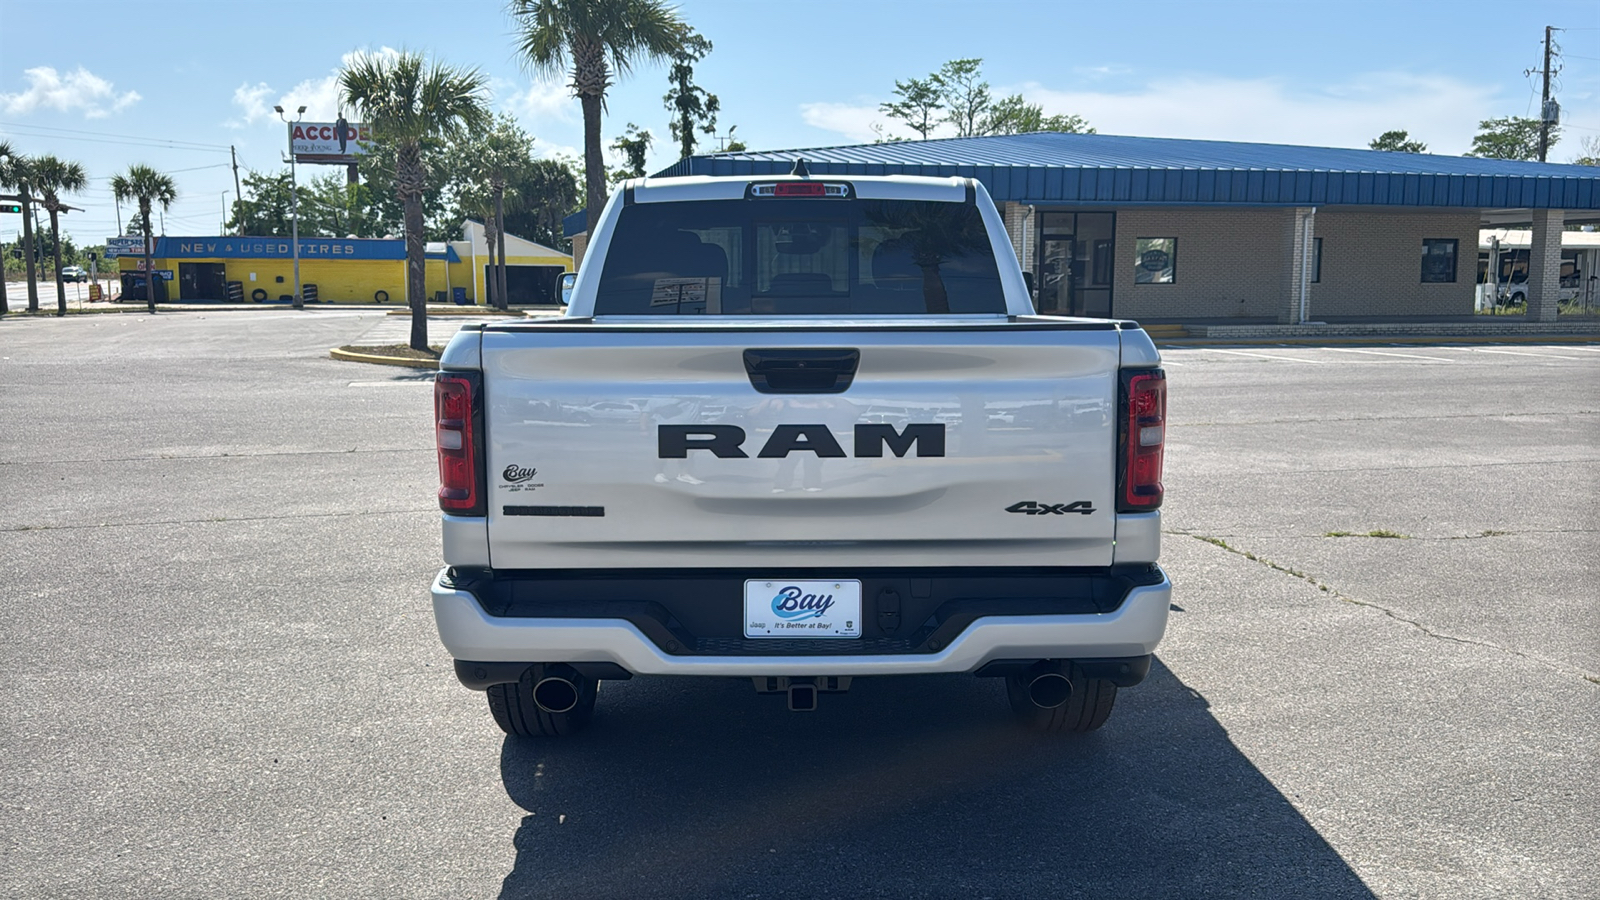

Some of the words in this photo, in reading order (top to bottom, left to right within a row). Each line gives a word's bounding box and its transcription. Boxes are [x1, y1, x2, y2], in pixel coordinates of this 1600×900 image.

[293, 125, 374, 141] ACCIDE
[181, 243, 216, 253] NEW
[240, 243, 288, 254] USED
[297, 244, 354, 254] TIRES
[658, 423, 946, 459] RAM
[505, 464, 537, 479] Bay
[1004, 501, 1097, 515] 4x4
[776, 586, 835, 618] Bay
[750, 621, 766, 629] Jeep
